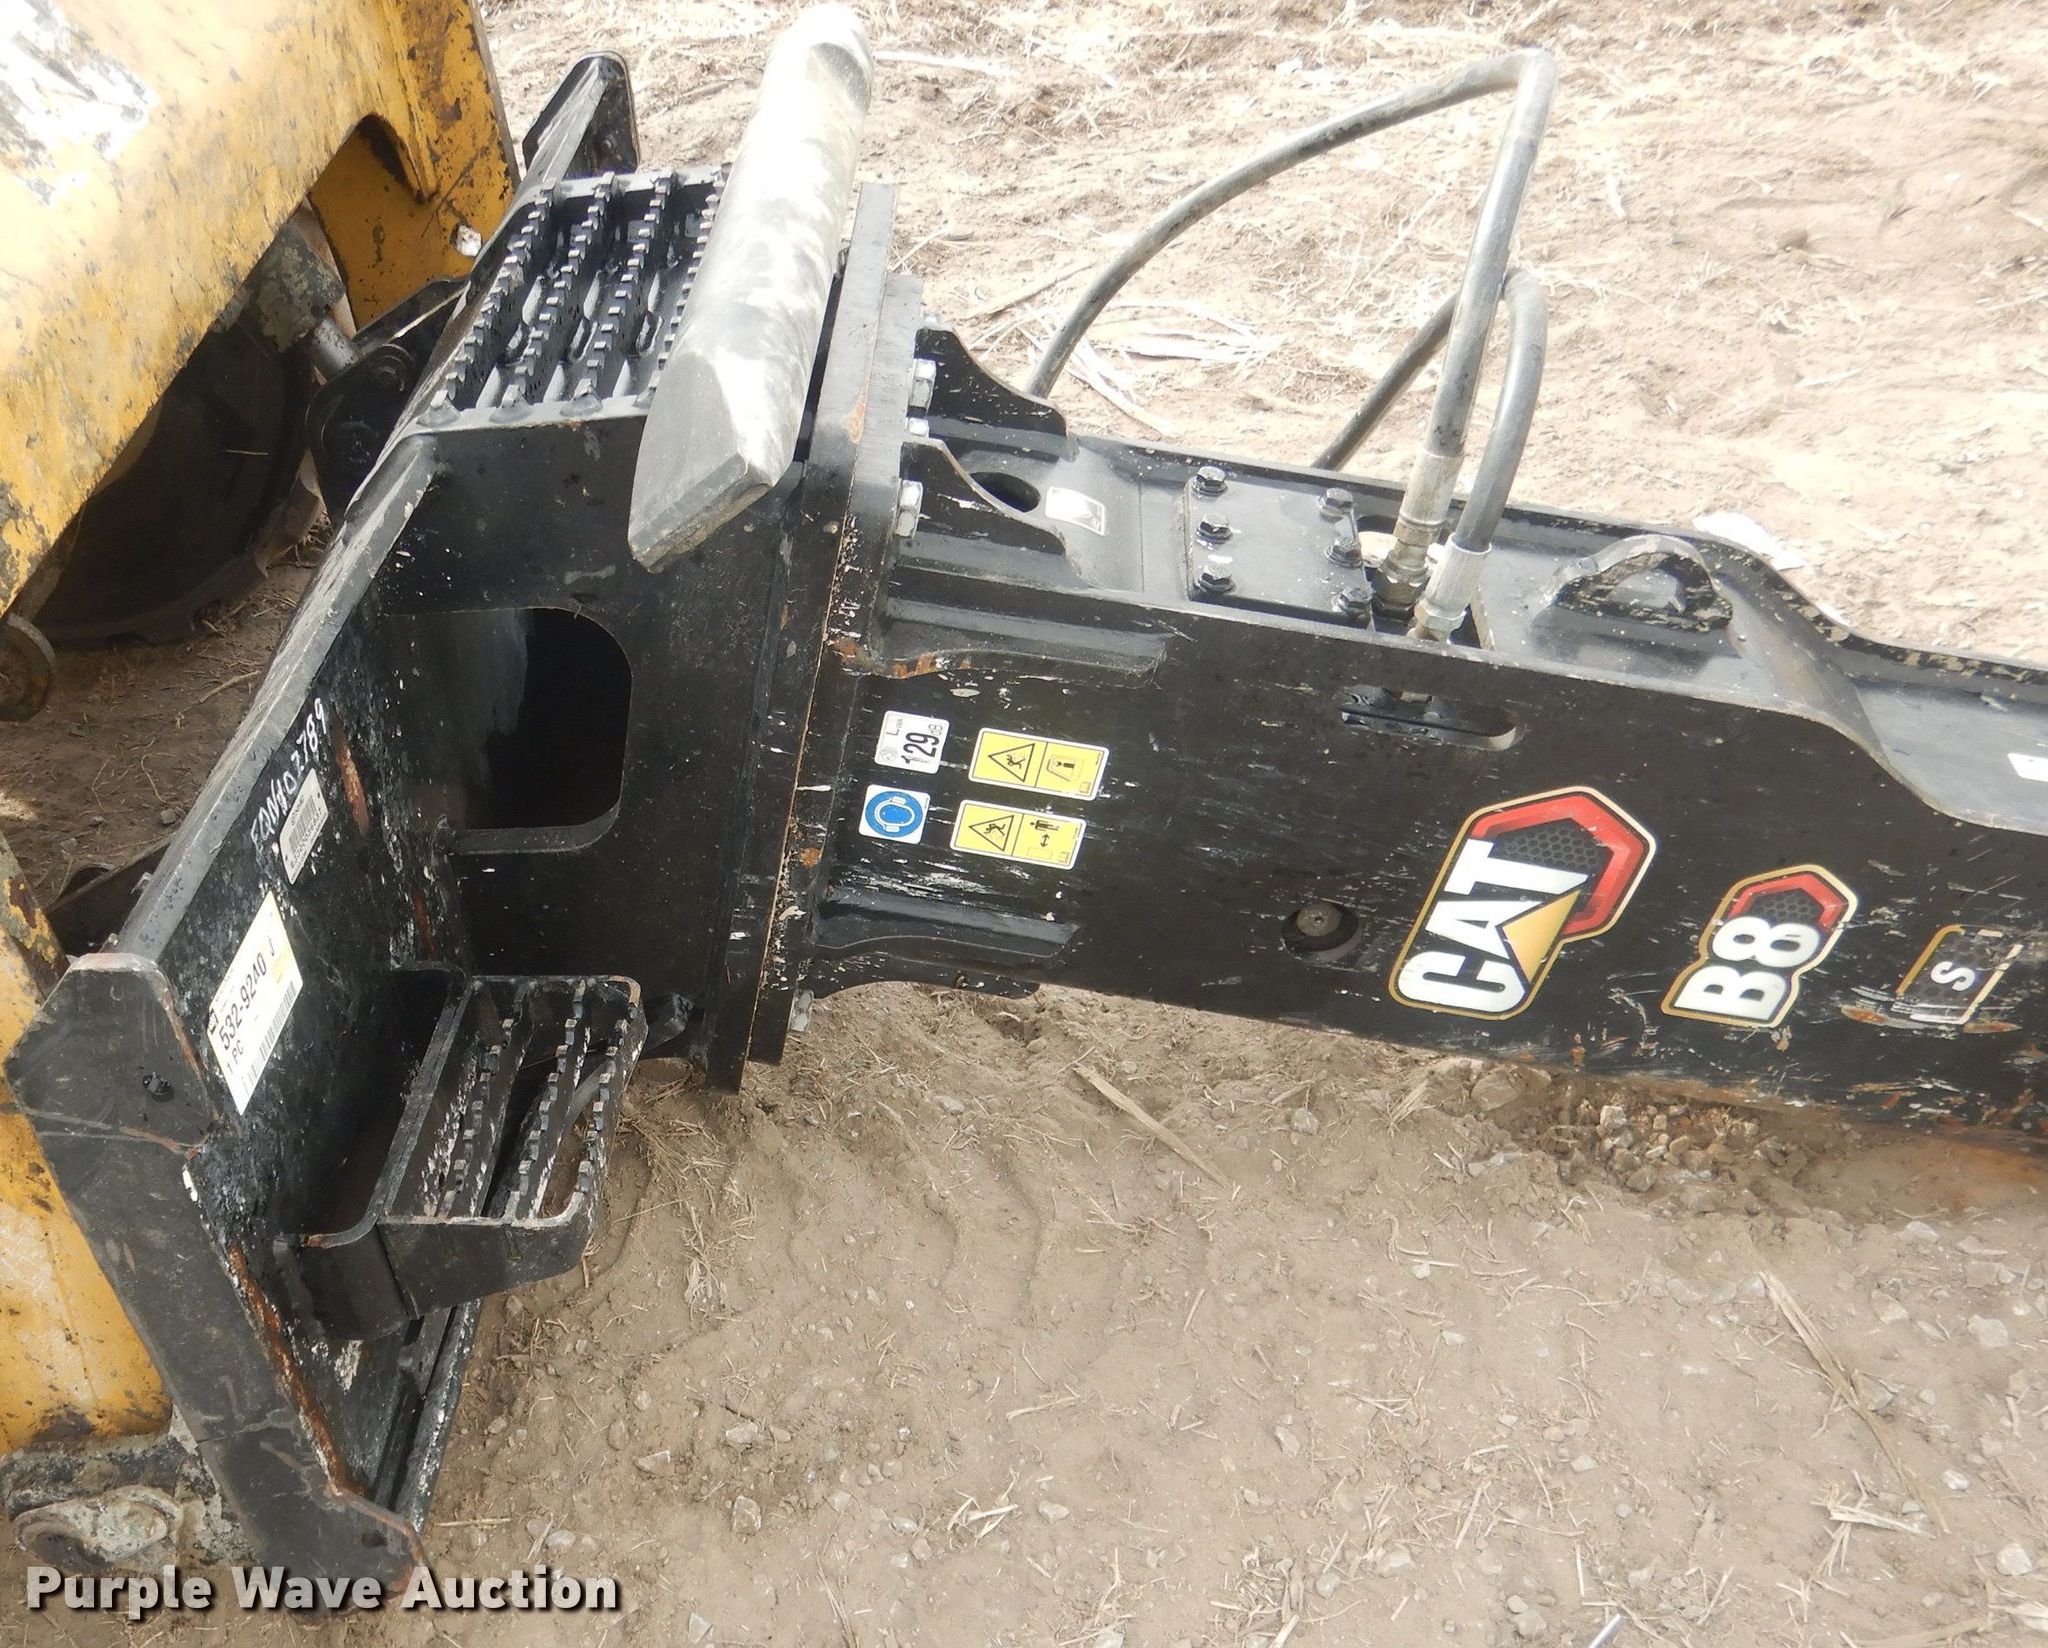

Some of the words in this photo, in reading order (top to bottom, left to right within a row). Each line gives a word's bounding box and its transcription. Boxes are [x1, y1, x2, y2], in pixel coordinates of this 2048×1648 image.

[901, 732, 940, 765] 129
[1397, 838, 1589, 1013] CAT
[219, 952, 267, 1050] 532-9240
[1673, 916, 1822, 1022] B8
[1930, 960, 1976, 992] S
[231, 1040, 244, 1065] PC
